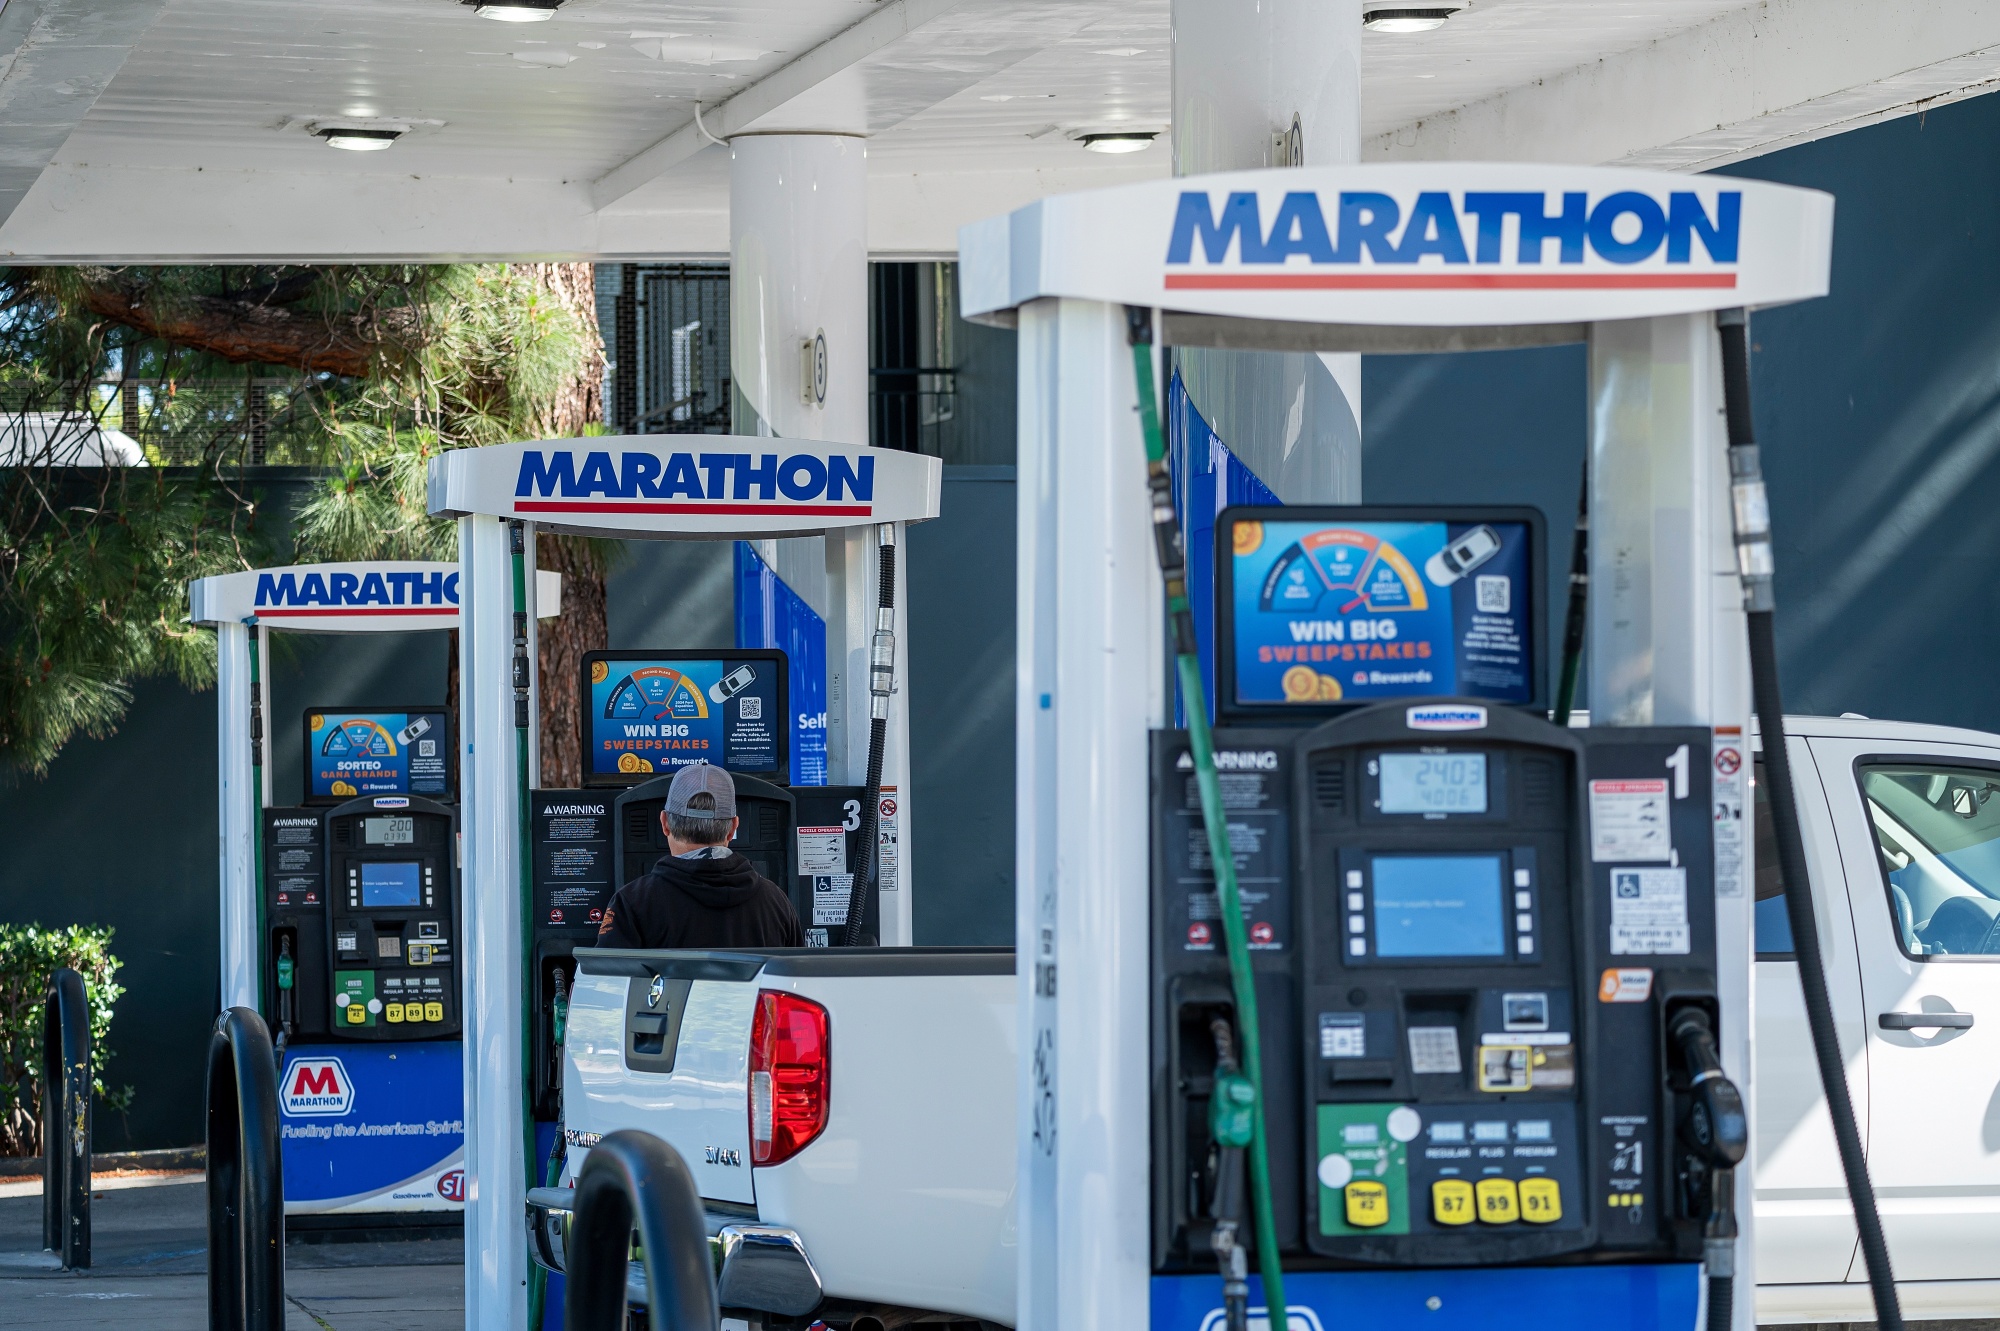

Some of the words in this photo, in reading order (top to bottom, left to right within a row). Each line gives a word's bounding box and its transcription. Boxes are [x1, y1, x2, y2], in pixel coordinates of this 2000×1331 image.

[1164, 191, 1743, 264] MARATHON
[818, 352, 823, 385] 5
[514, 451, 875, 501] MARATHON
[254, 572, 459, 606] MARATH
[1289, 620, 1344, 642] WIN
[1350, 619, 1398, 640] BIG
[1259, 641, 1432, 663] SWEEPSTAKES
[1370, 670, 1433, 684] Rewards
[799, 713, 826, 729] Self
[624, 725, 656, 737] WIN
[661, 724, 689, 736] BIG
[604, 740, 709, 750] SWEEPSTAKES
[337, 761, 381, 771] SORTEO
[671, 757, 709, 765] Rewards
[1211, 750, 1278, 769] ARNING
[321, 771, 351, 779] GANA
[354, 770, 398, 778] GRANDE
[1665, 744, 1690, 799] 1
[552, 804, 605, 815] WARNING
[843, 800, 861, 831] 3
[280, 818, 318, 827] WARNING
[293, 1067, 340, 1095] M
[290, 1097, 343, 1107] MARATHON
[282, 1124, 332, 1139] Fueling
[333, 1123, 356, 1137] the
[356, 1122, 424, 1137] American
[1425, 1148, 1471, 1158] REGULAR
[1479, 1147, 1505, 1158] PLUS
[442, 1173, 464, 1197] ST
[1442, 1197, 1464, 1210] 87
[1486, 1196, 1509, 1210] 89
[1528, 1196, 1551, 1209] 91
